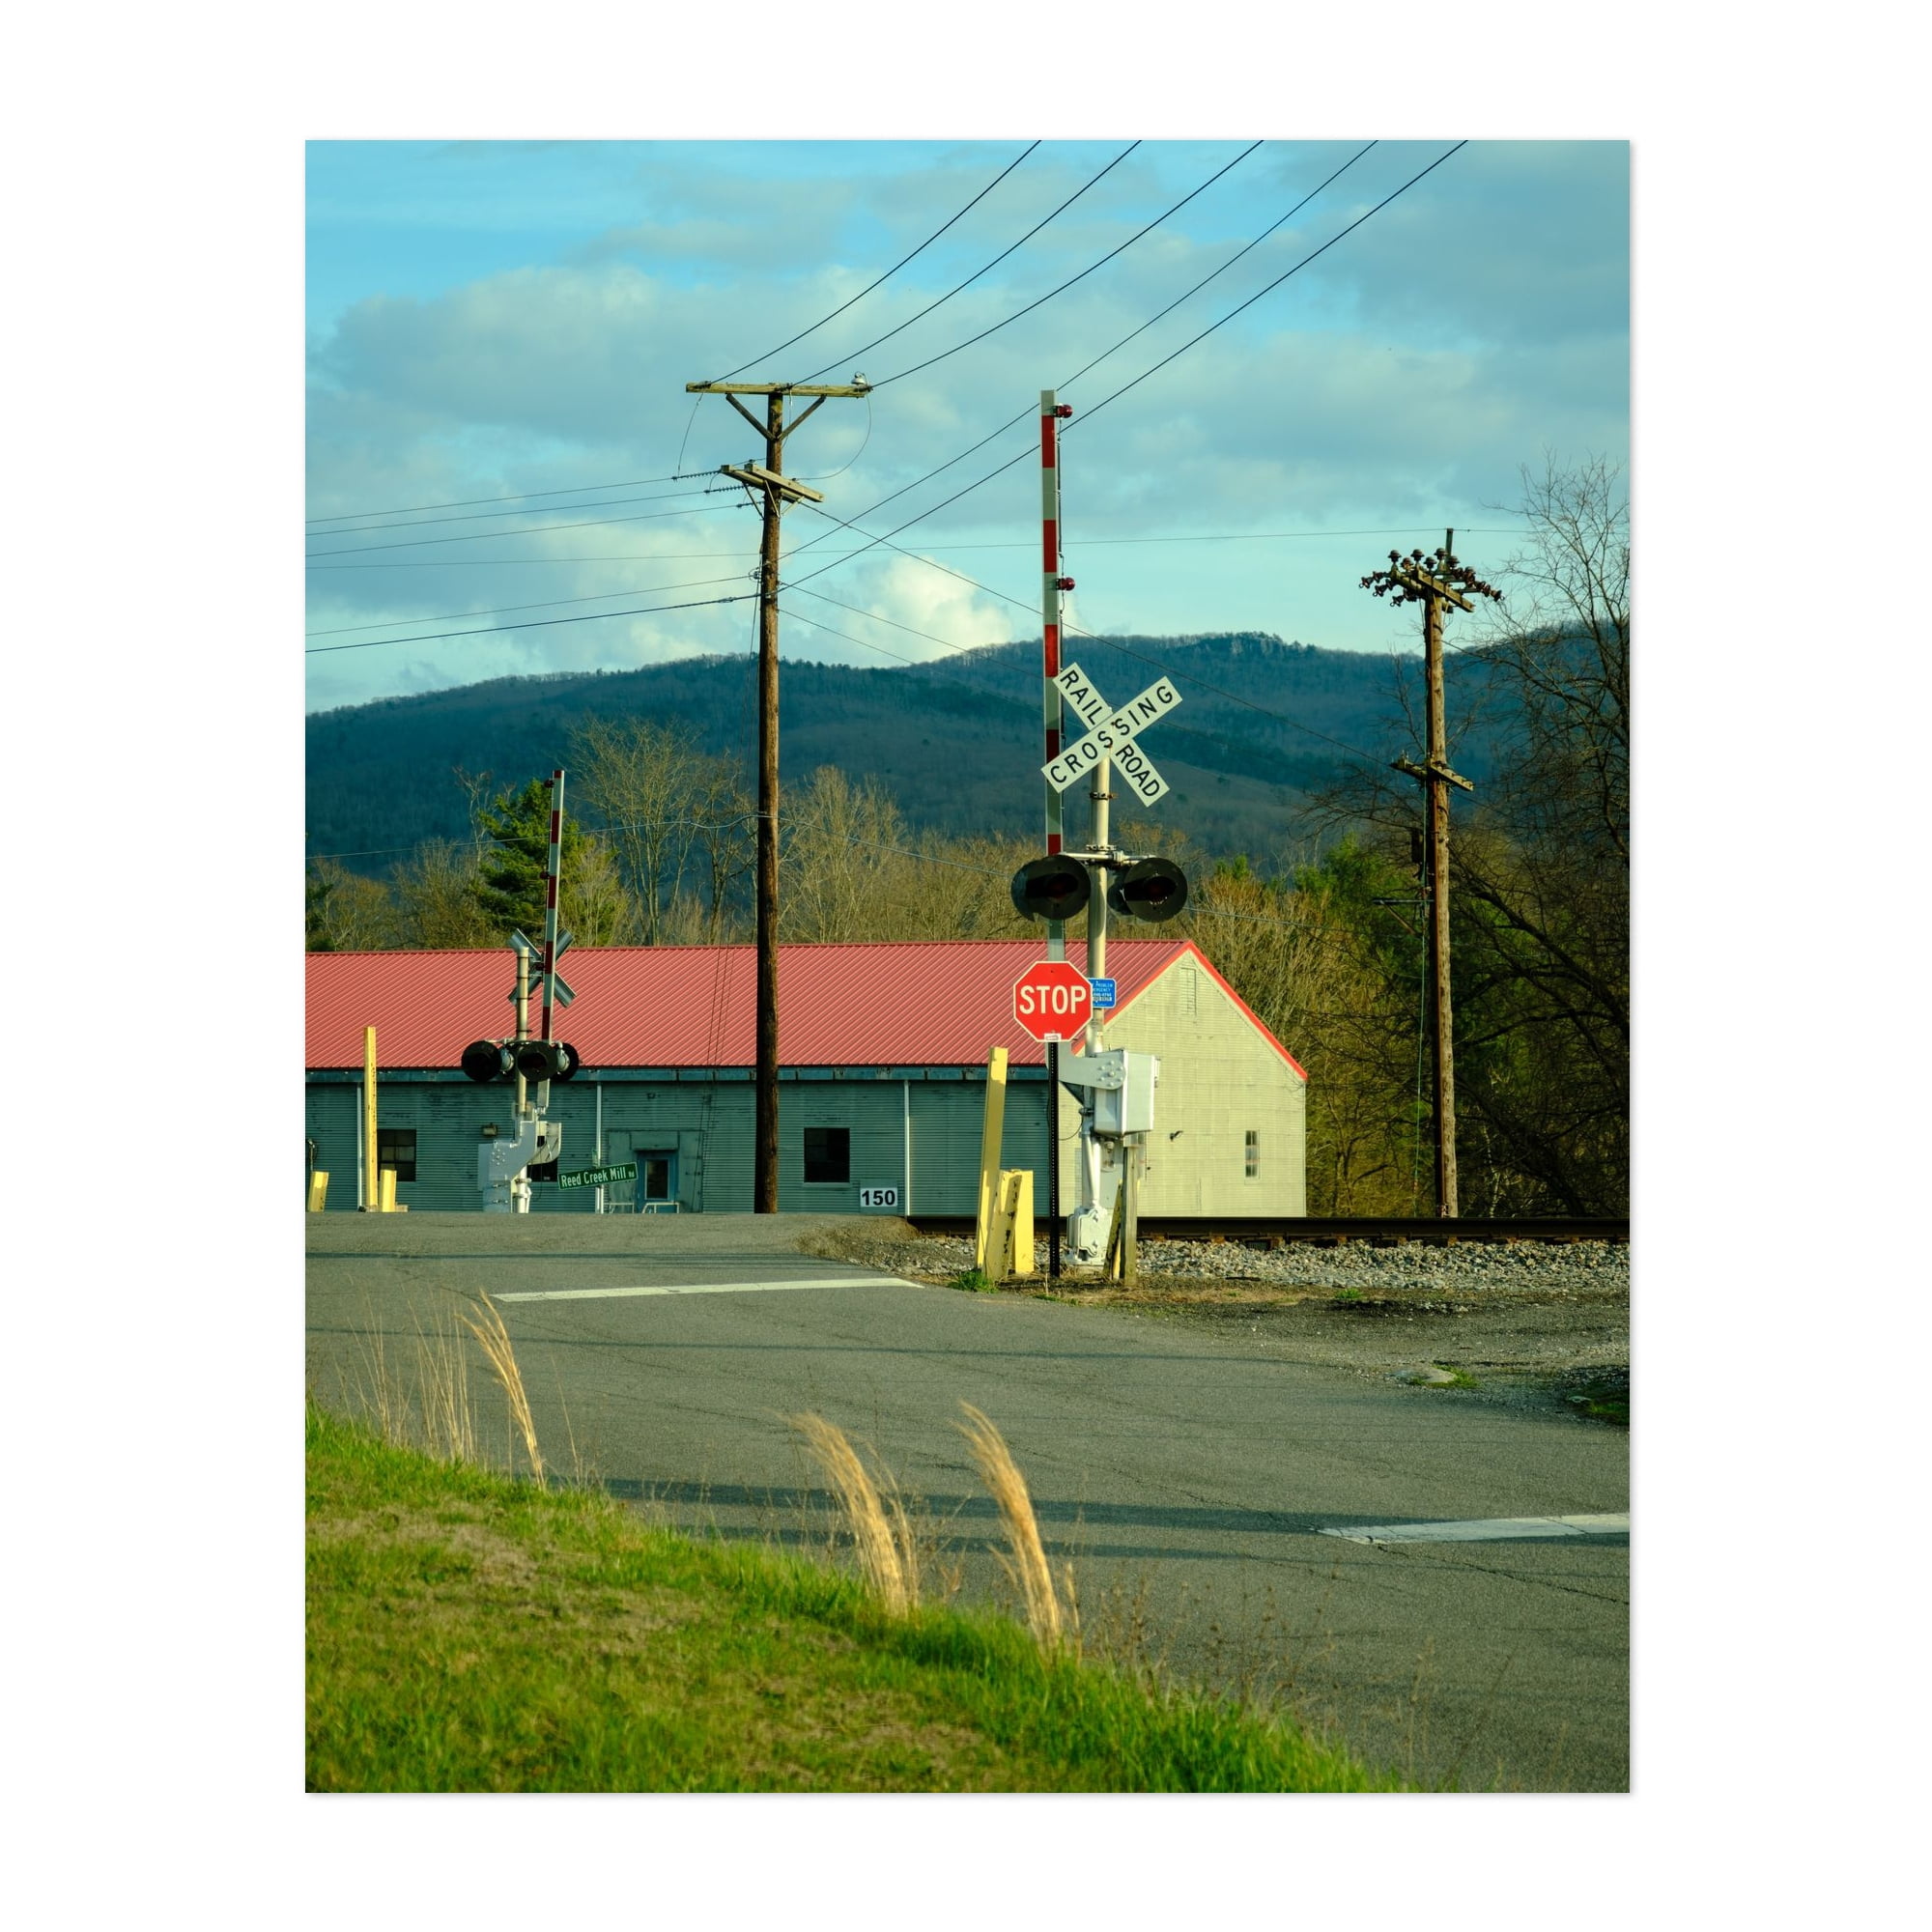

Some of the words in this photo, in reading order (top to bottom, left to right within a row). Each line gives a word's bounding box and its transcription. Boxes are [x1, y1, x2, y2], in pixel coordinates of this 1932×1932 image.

[1050, 686, 1173, 783] CROSSING
[1060, 669, 1102, 725] RAIL
[1116, 744, 1160, 797] ROAD
[1019, 984, 1087, 1014] STOP
[560, 1173, 582, 1187] Reed
[583, 1170, 609, 1184] Creek
[610, 1166, 627, 1180] Mill
[628, 1170, 635, 1179] Rd
[862, 1190, 895, 1206] 150
